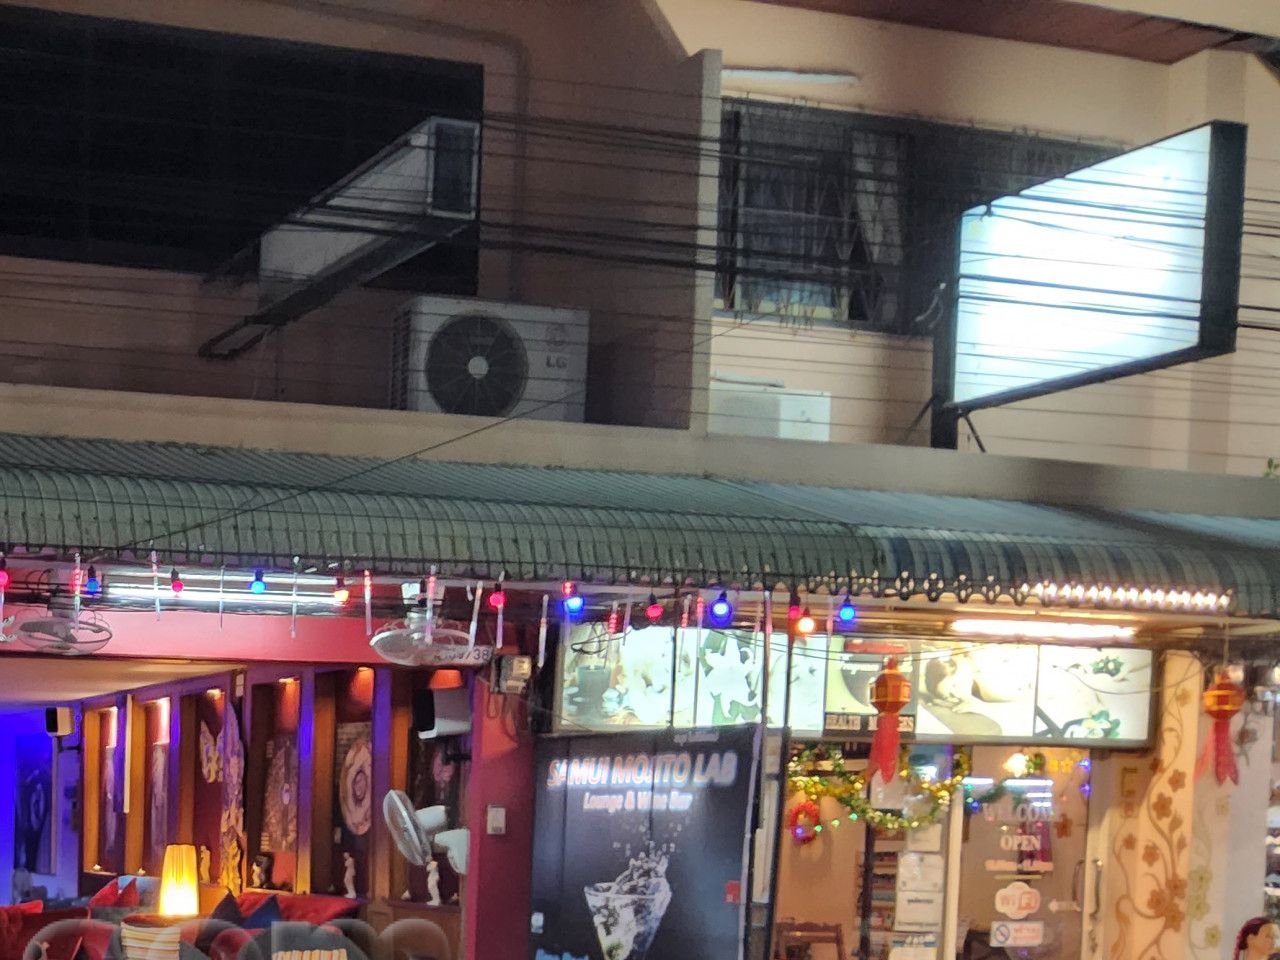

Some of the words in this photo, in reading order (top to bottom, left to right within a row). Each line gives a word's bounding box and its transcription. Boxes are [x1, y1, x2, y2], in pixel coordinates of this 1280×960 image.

[545, 355, 568, 368] LG
[547, 758, 611, 787] SAMUI
[612, 752, 692, 784] MOJITO
[693, 751, 738, 786] LAB
[1000, 835, 1041, 850] OPEN
